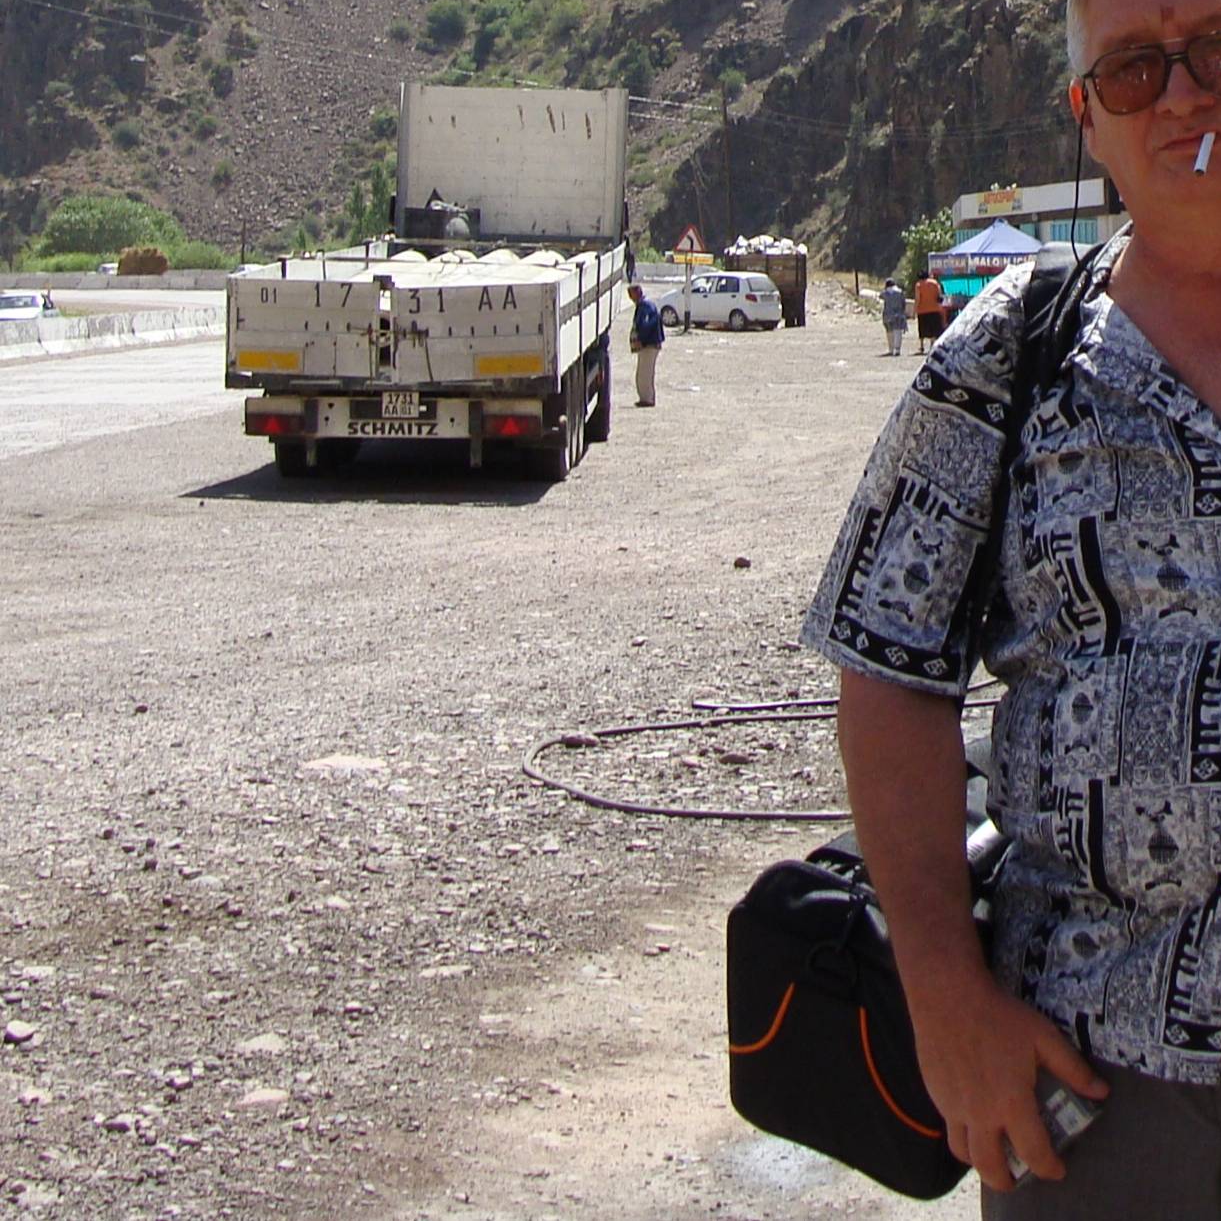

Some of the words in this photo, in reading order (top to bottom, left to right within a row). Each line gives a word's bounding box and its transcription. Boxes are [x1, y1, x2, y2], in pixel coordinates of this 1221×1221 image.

[260, 286, 278, 304] 01
[387, 393, 413, 405] 1731
[347, 421, 438, 436] SCHMITZ
